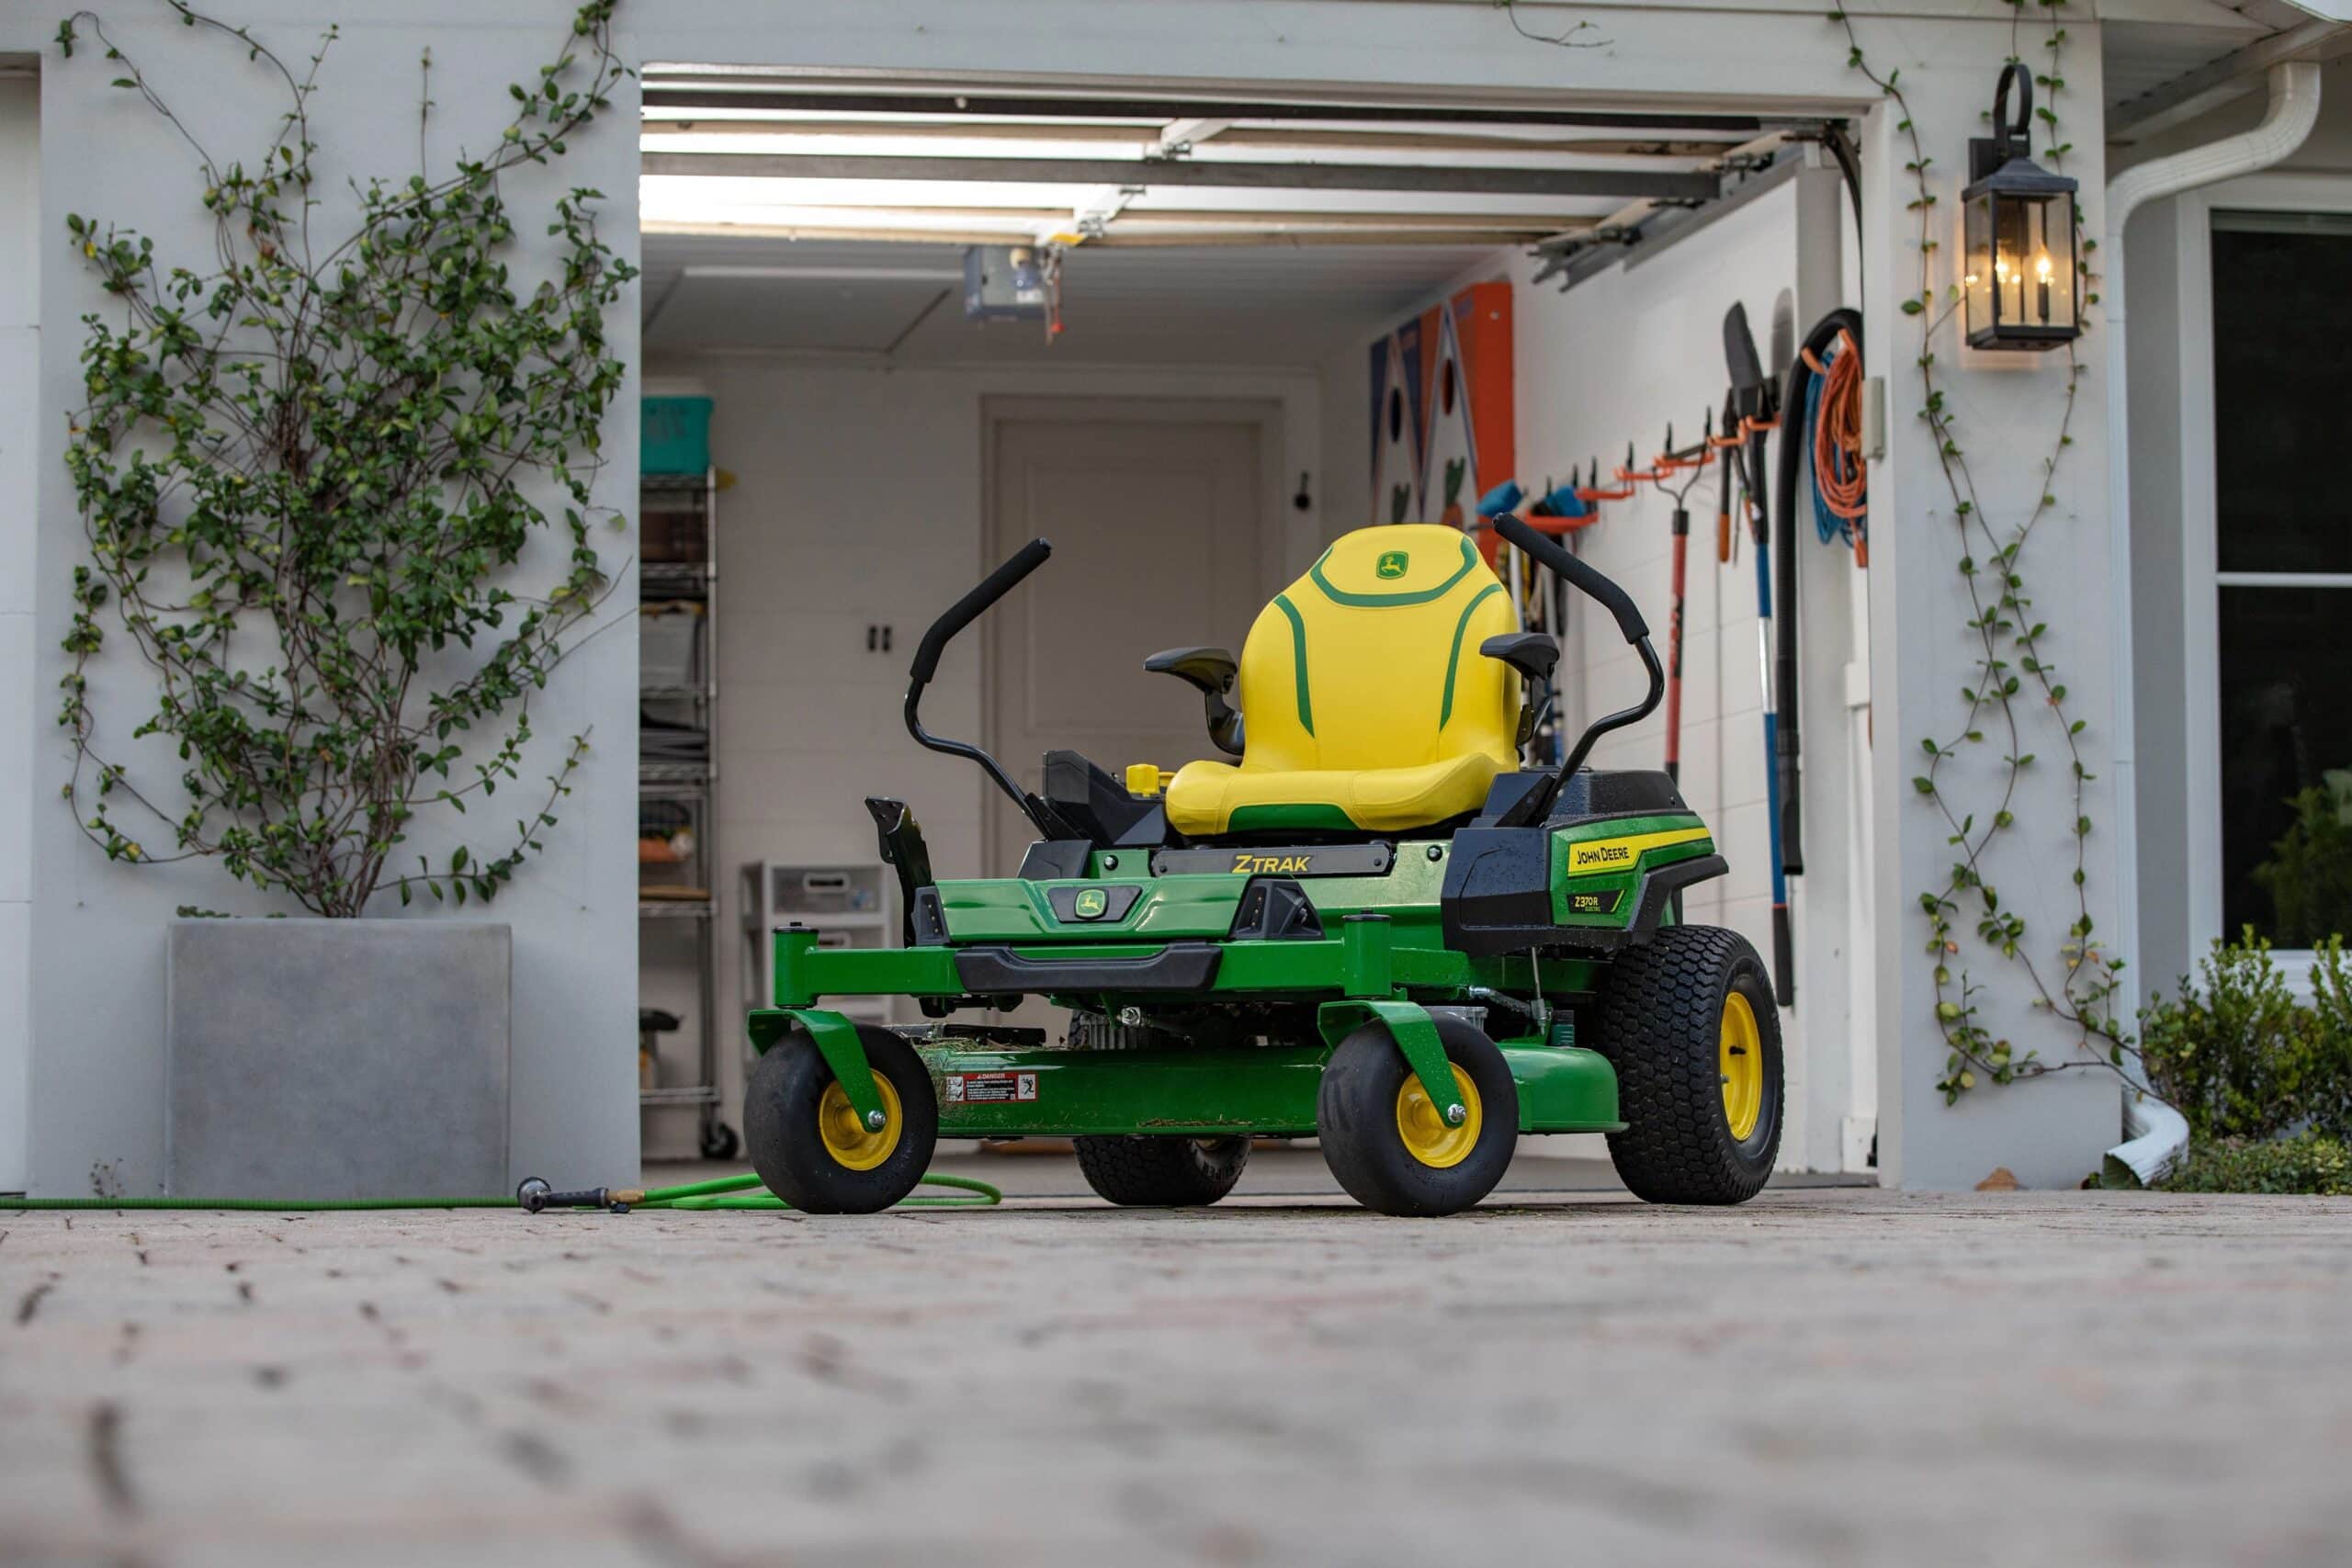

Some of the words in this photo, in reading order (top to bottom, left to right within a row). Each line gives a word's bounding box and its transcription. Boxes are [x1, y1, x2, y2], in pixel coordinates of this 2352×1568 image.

[1232, 854, 1311, 873] ZTRAK
[1577, 850, 1600, 864] JOHN
[1600, 847, 1629, 861] DEERE
[1575, 896, 1599, 908] Z370R
